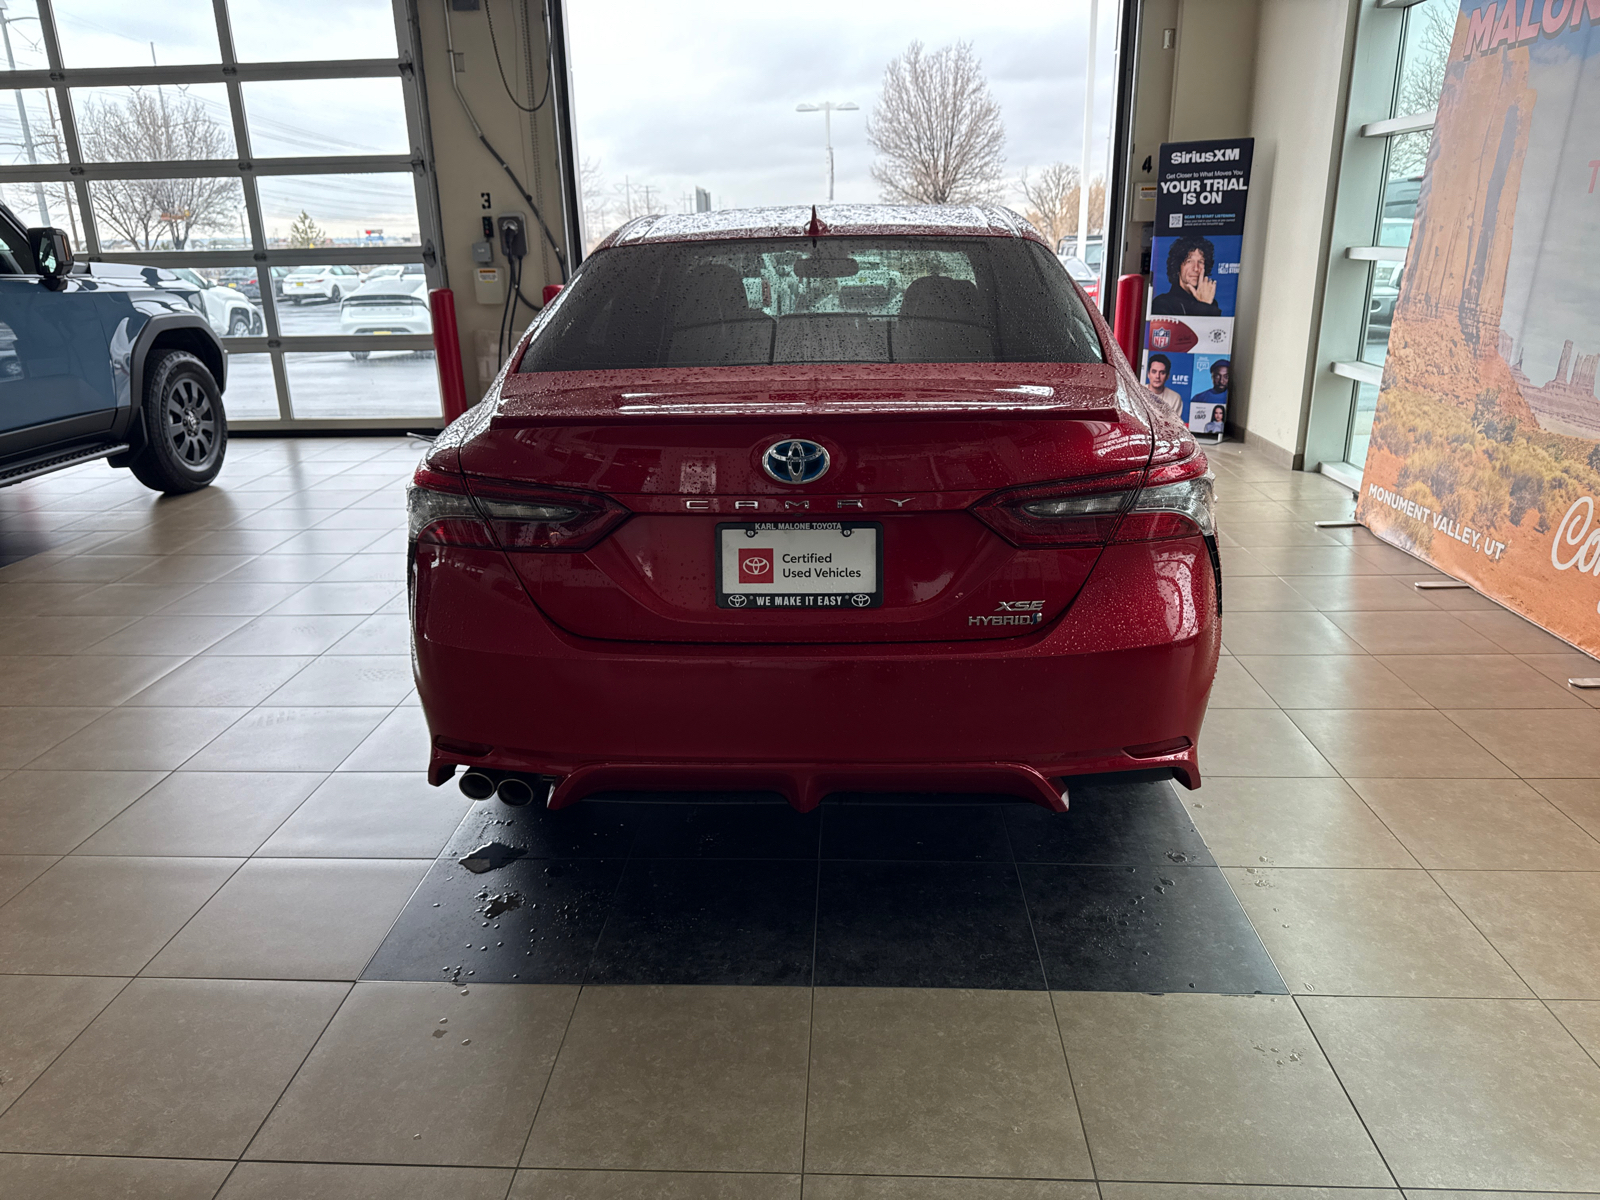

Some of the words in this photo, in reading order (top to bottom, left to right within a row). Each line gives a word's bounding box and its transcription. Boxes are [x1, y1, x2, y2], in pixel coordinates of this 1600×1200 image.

[1171, 148, 1240, 165] SiriusXM
[1142, 155, 1152, 174] 4
[1160, 179, 1201, 194] YOUR
[1204, 178, 1247, 192] TRIAL
[481, 192, 491, 209] 3
[1182, 193, 1196, 206] IS
[1200, 192, 1222, 205] ON
[1154, 336, 1168, 347] NFL
[1172, 374, 1189, 382] LIFE
[685, 497, 916, 509] CAMRY
[812, 522, 842, 530] TOYOTA
[1368, 483, 1431, 523] MONUMENT
[1432, 511, 1481, 553] VALLEY,
[1483, 539, 1506, 560] UT
[782, 553, 832, 563] Certified
[782, 567, 812, 578] Used
[814, 567, 861, 578] Vehicles
[756, 596, 771, 606] WE
[775, 596, 802, 606] MAKE
[805, 596, 813, 606] IT
[817, 596, 842, 606] EASY
[994, 600, 1046, 611] XSE
[968, 615, 1031, 626] HYBRID
